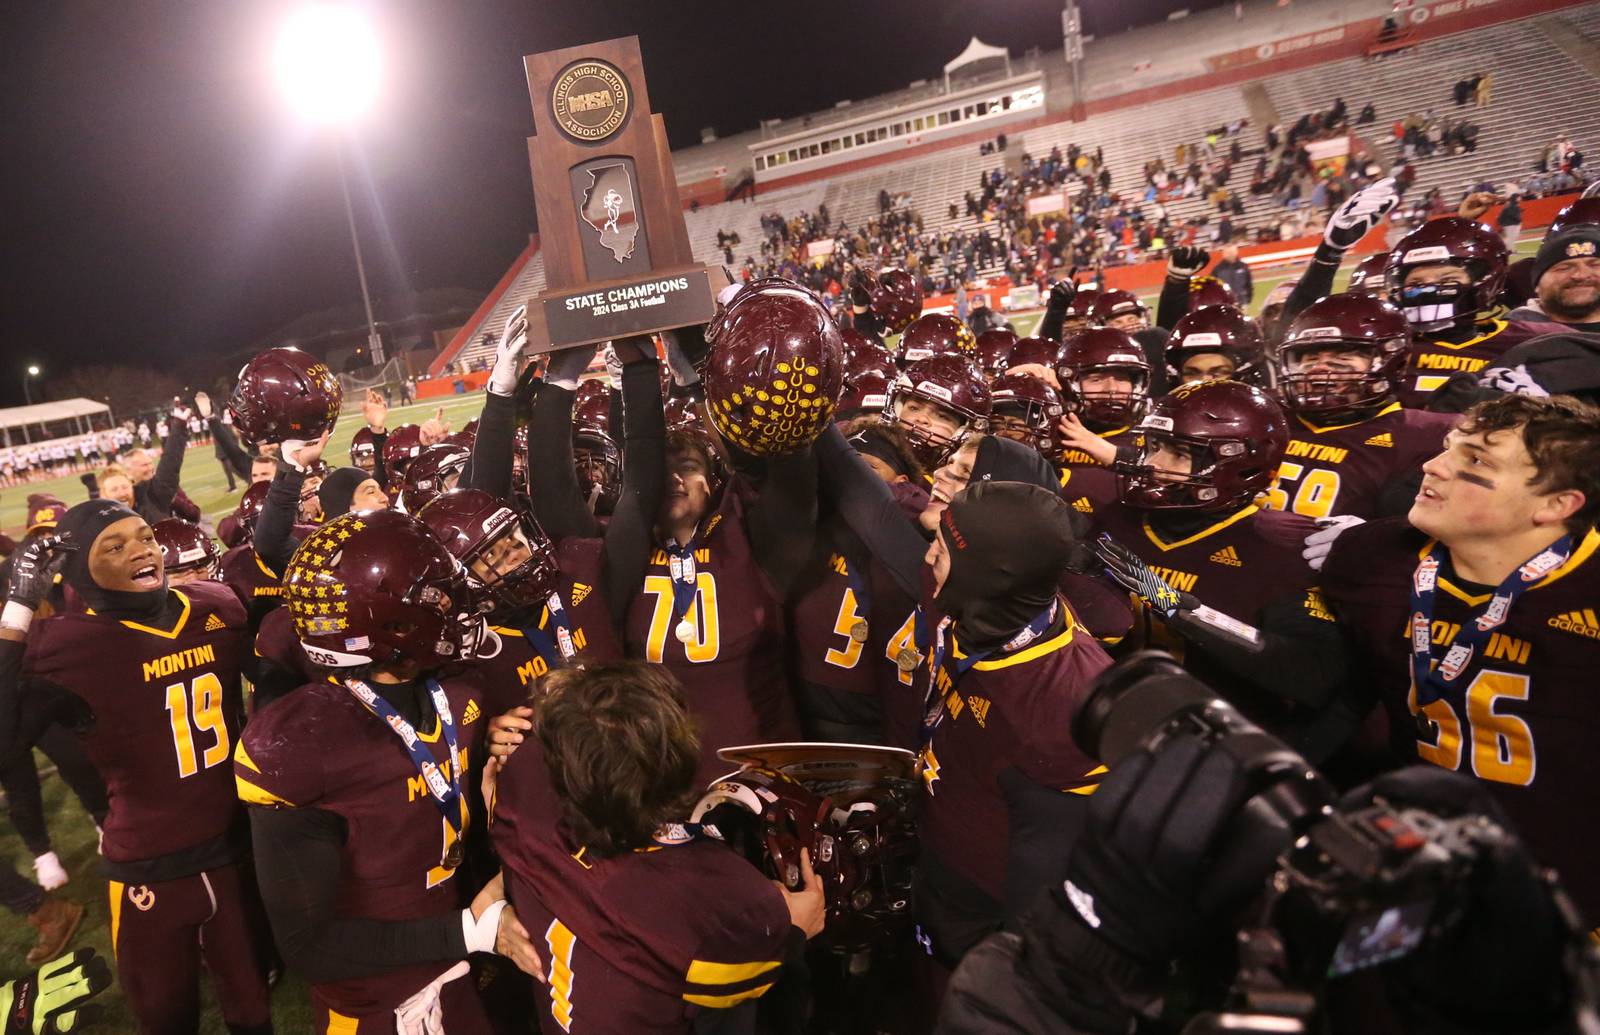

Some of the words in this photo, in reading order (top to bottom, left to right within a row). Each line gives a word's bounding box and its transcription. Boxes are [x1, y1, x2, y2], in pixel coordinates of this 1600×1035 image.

[557, 75, 574, 115] ILLINOIS
[574, 67, 597, 77] HIGH
[600, 70, 624, 104] SCHOOL
[566, 110, 621, 136] ASSOCIATION
[565, 293, 604, 310] STATE
[608, 278, 688, 302] CHAMPIONS
[593, 305, 610, 316] 2024
[611, 303, 628, 312] Class
[629, 300, 639, 310] 3A
[640, 295, 665, 307] Football
[1416, 353, 1490, 373] MONTIN
[1285, 440, 1349, 464] ONTINI
[254, 586, 284, 597] MONT
[643, 571, 720, 664] 70
[1547, 617, 1600, 640] adida
[142, 644, 216, 682] MONTINI
[165, 672, 230, 779] 19
